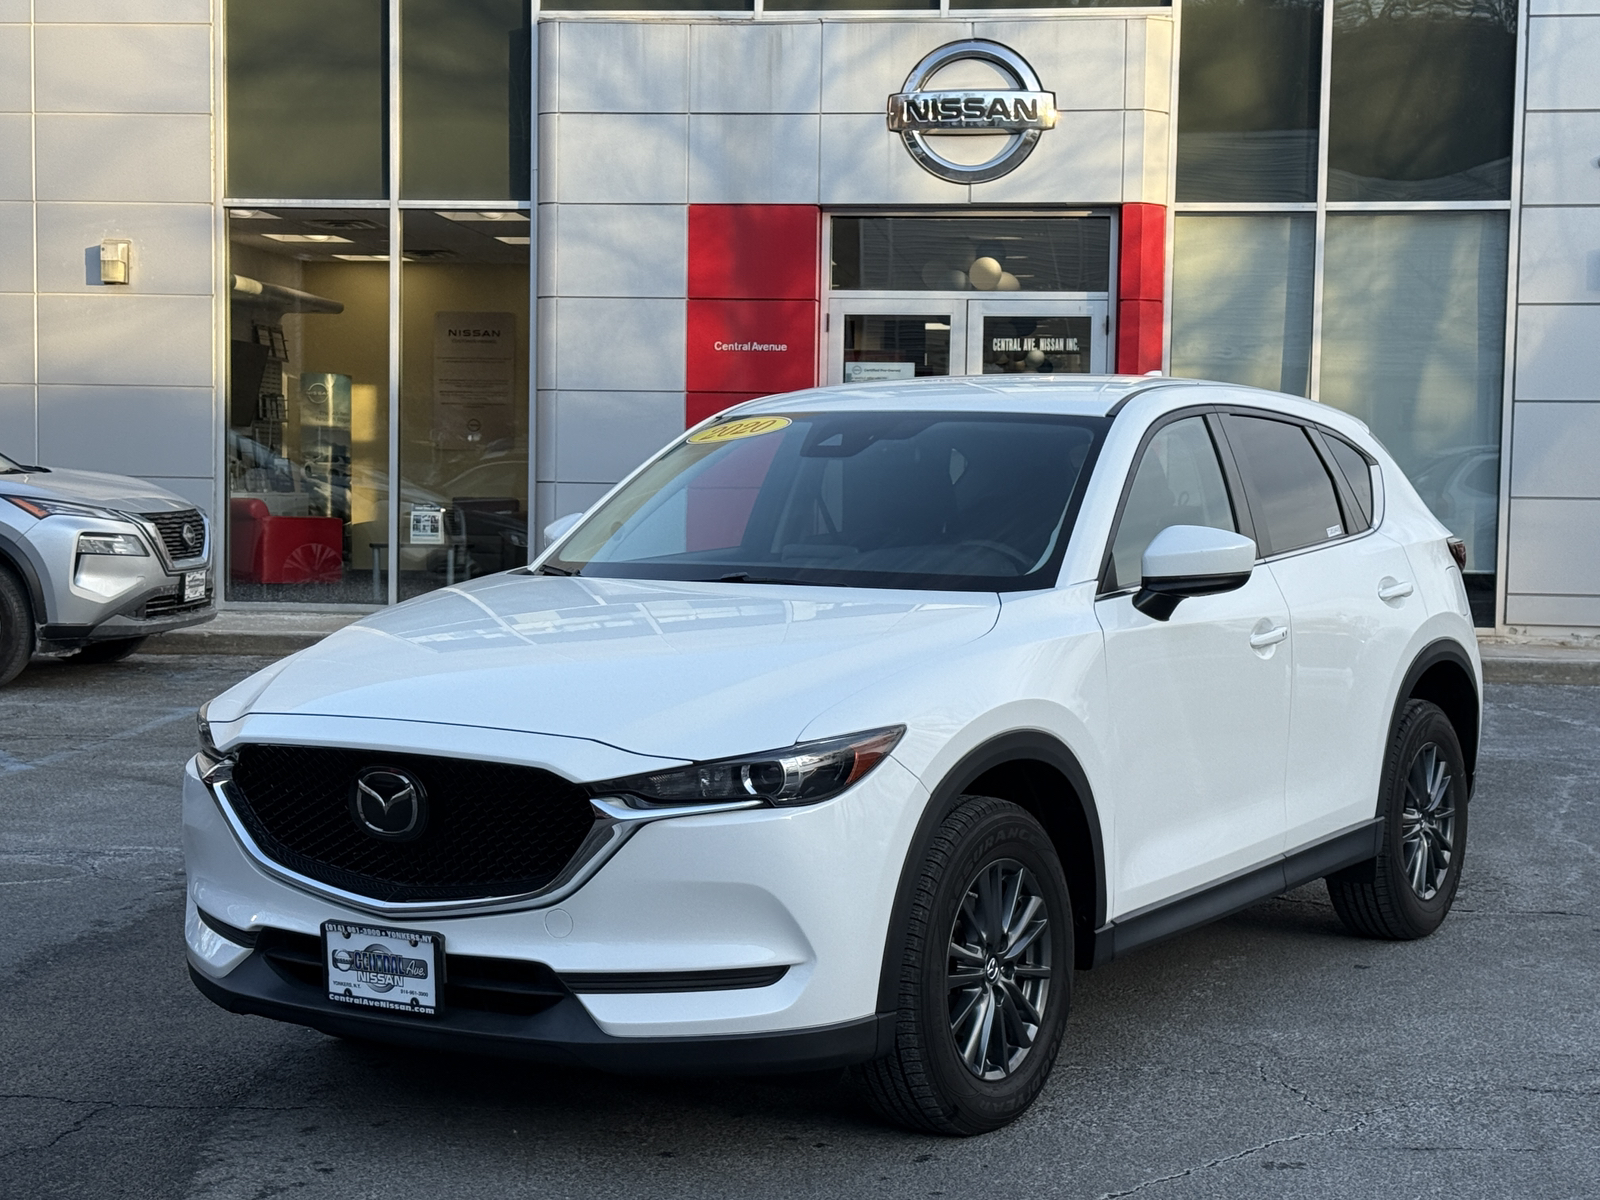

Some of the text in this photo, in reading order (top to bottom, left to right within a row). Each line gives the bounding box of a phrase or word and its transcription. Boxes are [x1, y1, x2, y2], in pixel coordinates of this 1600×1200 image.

[903, 97, 1038, 122] NISSAN
[448, 329, 501, 337] NISSAN
[714, 341, 788, 351] Central Avenue
[992, 337, 1021, 351] CENTRAL
[1039, 337, 1064, 351] NISSAN
[1066, 338, 1080, 351] INC.
[699, 419, 777, 441] 2020
[325, 923, 345, 933] (914)
[354, 950, 425, 977] CENTRAL Ave.
[357, 971, 404, 988] NISSAN
[328, 993, 435, 1015] CentralAveNissan.com
